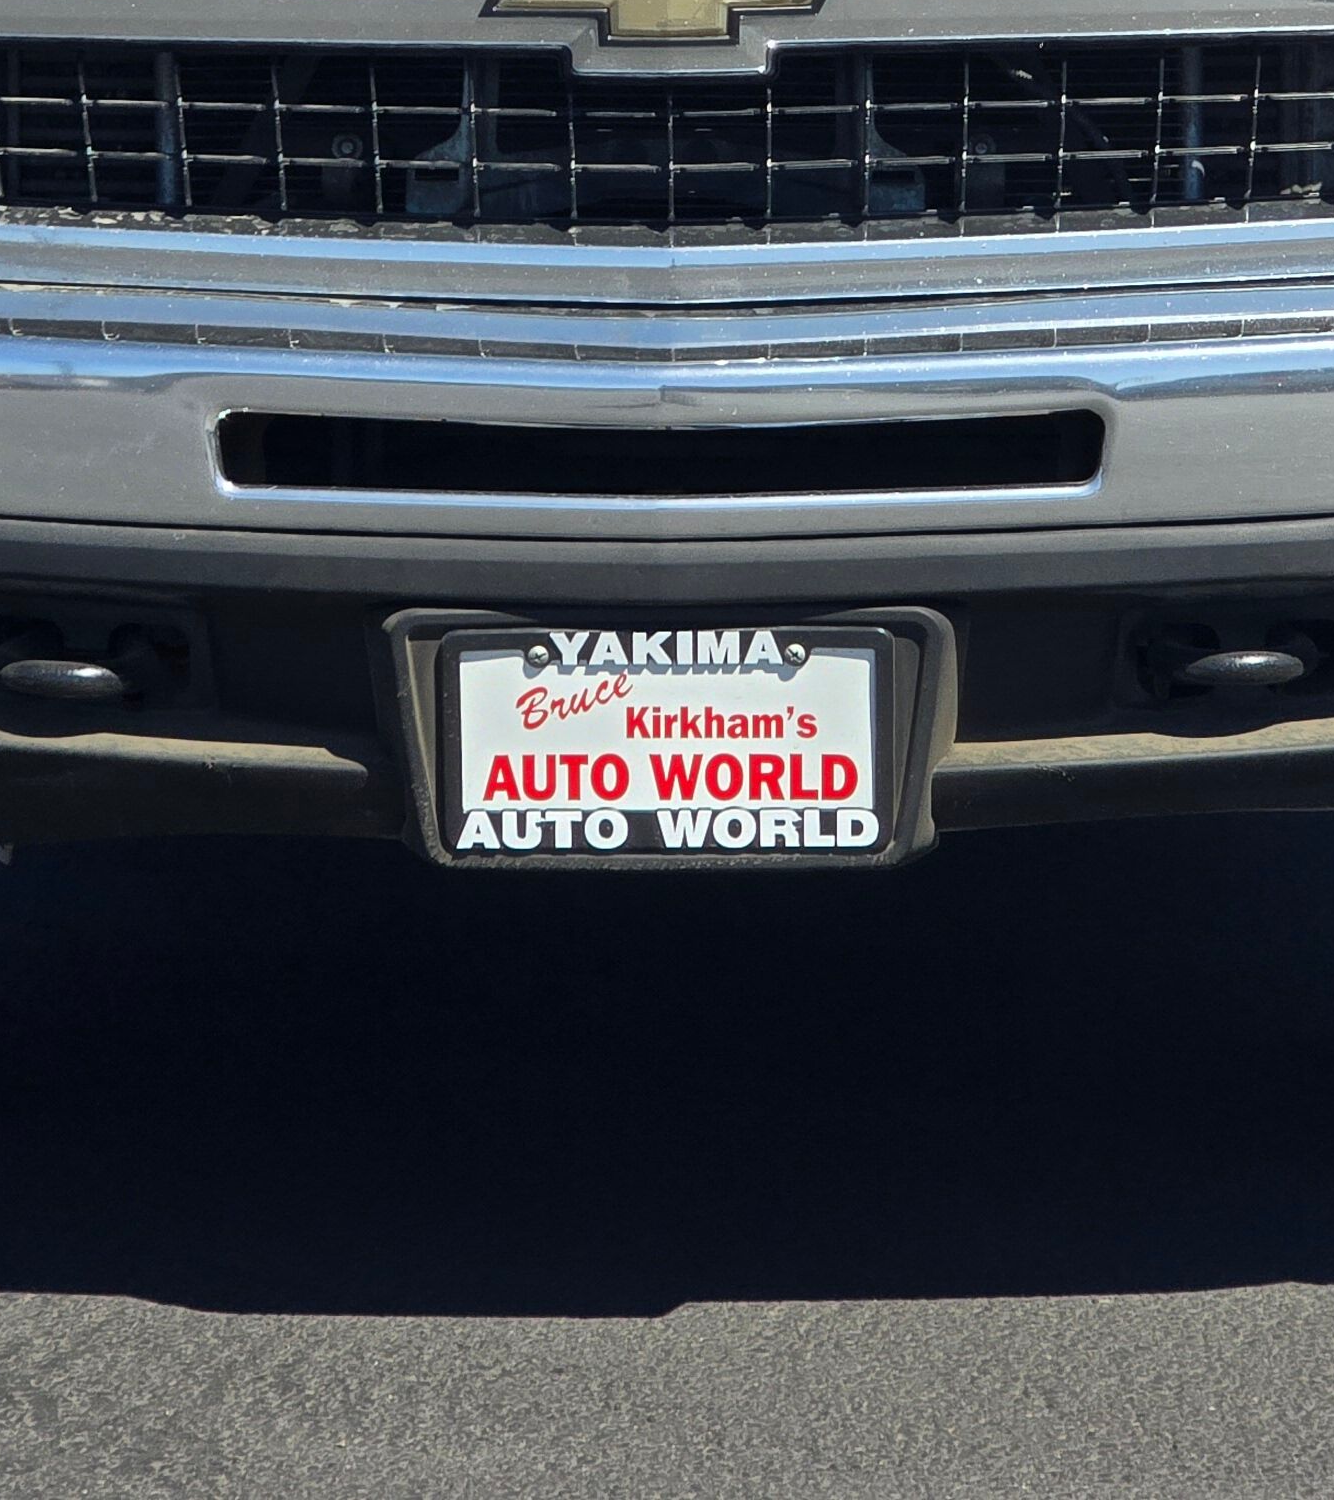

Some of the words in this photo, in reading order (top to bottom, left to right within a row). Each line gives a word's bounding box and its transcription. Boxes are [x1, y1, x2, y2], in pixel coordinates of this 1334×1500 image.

[550, 631, 783, 665] YAKIMA
[516, 671, 633, 730] Bruce
[626, 706, 817, 739] Kirkham's
[483, 753, 630, 801] AUTO
[650, 753, 858, 801] WORLD
[456, 809, 629, 850] AUTO
[656, 808, 880, 849] WORLD
